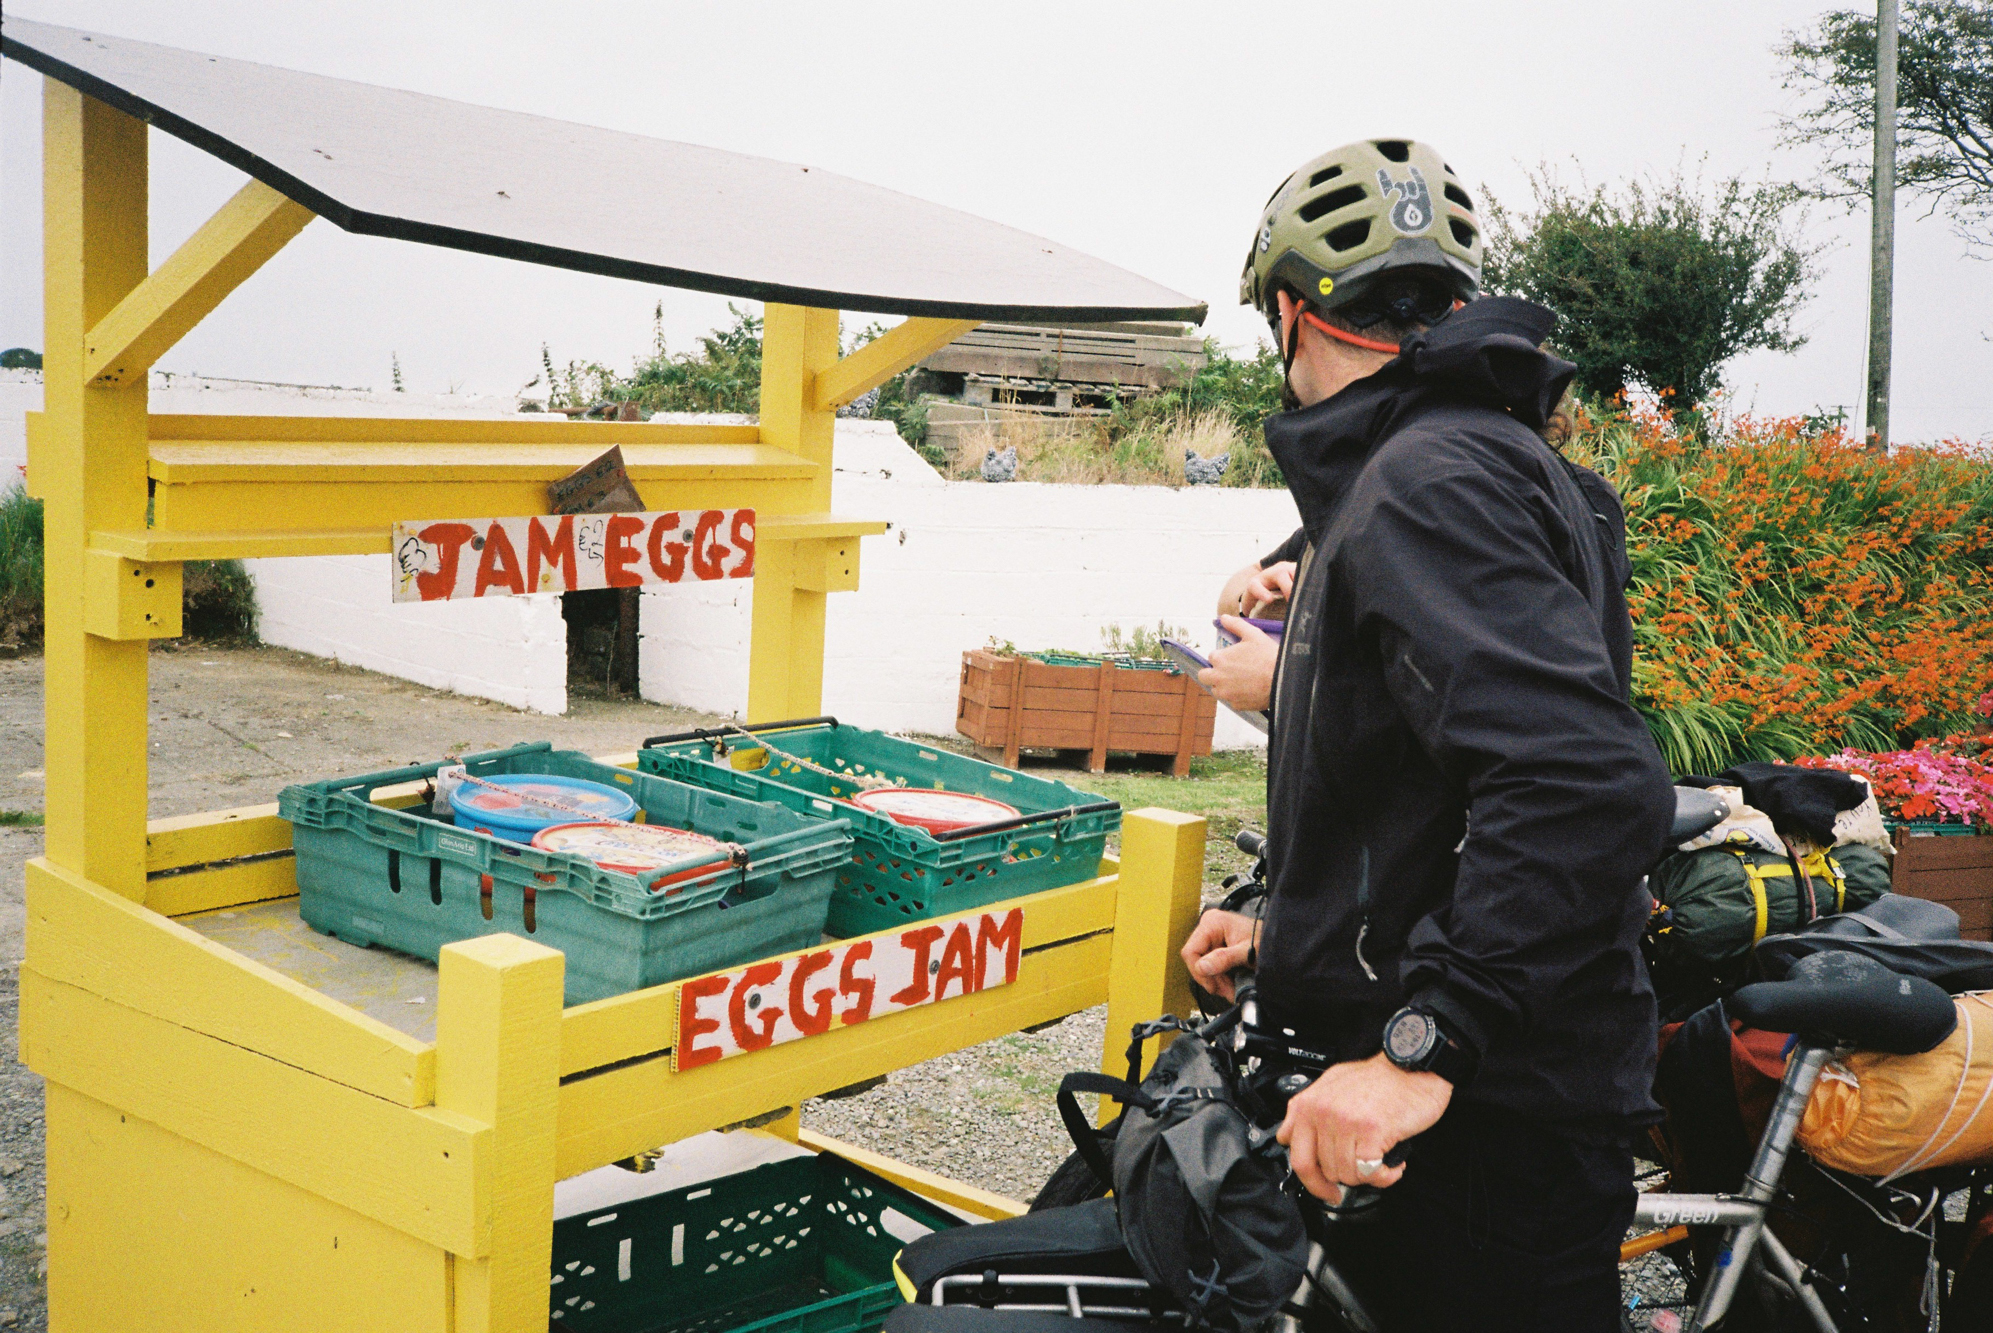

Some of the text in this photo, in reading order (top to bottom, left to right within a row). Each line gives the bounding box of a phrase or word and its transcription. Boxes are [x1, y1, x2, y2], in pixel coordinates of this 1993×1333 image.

[417, 509, 755, 601] JAM EGGS
[677, 907, 1024, 1071] EGGS JAM
